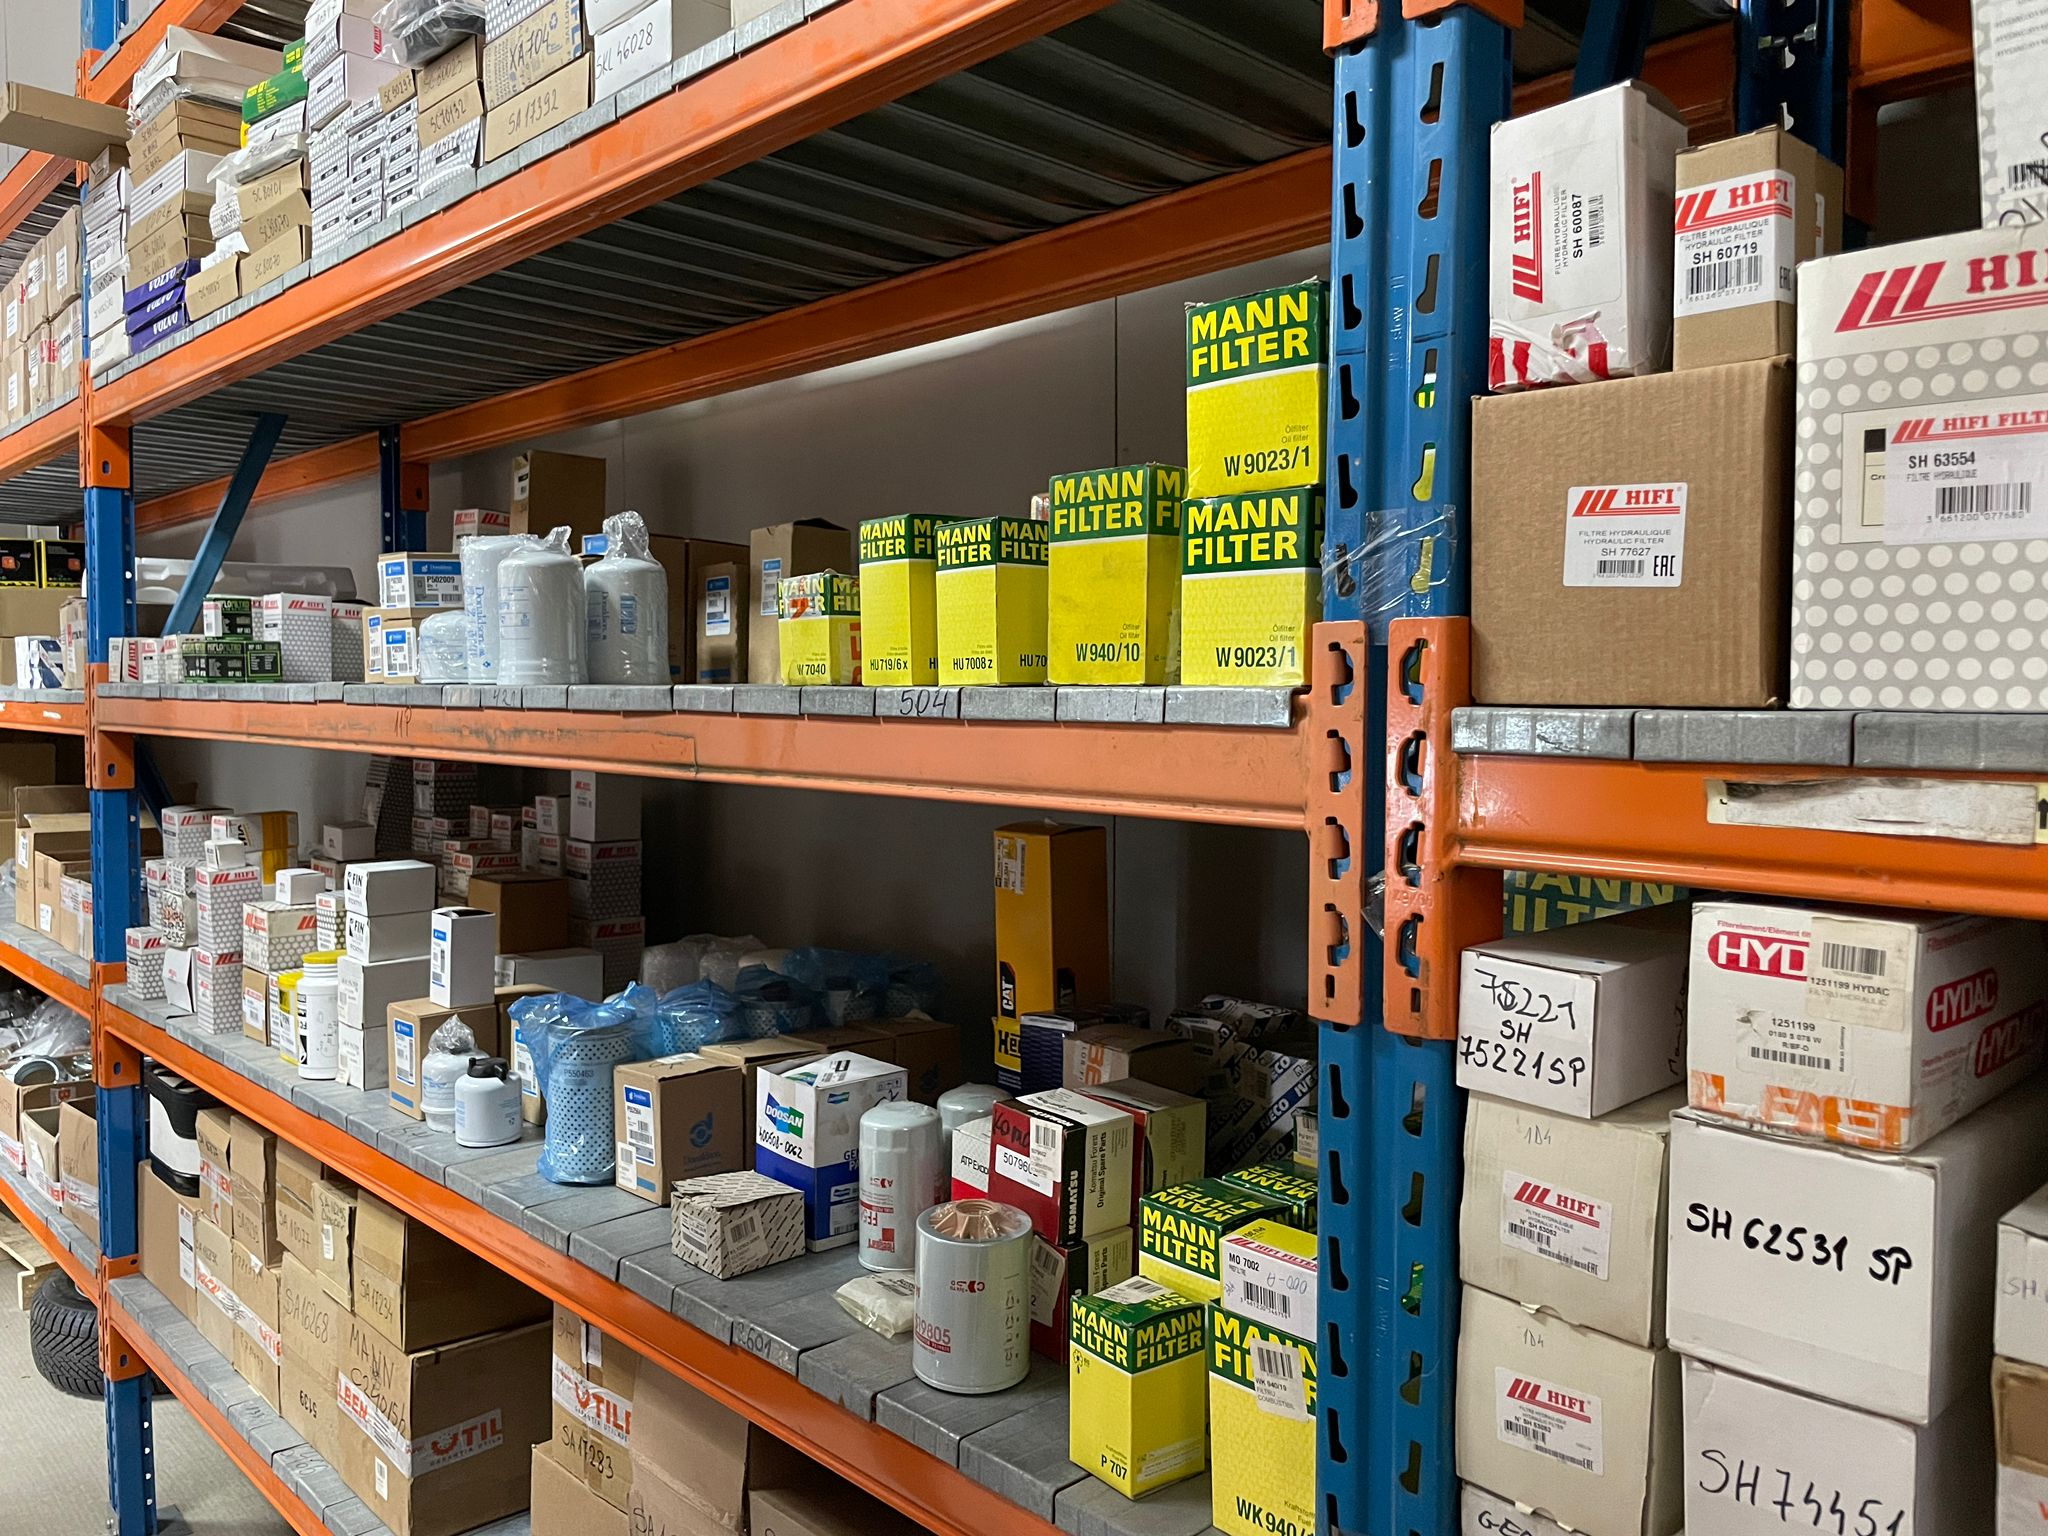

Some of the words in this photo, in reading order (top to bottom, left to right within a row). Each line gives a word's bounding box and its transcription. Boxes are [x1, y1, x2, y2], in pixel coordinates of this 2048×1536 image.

[527, 24, 551, 59] 704
[1560, 189, 1568, 217] FILTER
[1729, 178, 1789, 208] HIFI
[1513, 182, 1531, 244] HIFI
[1572, 194, 1582, 229] 60087
[1685, 236, 1731, 251] HYDRAULIC
[1734, 229, 1763, 244] FILTER
[1709, 218, 1770, 238] HYDRAULIQUE
[1572, 232, 1583, 258] SH
[1692, 251, 1712, 265] SH
[1717, 242, 1758, 261] 60719
[1966, 250, 2048, 294] HI
[152, 311, 179, 335] VOLVO
[1192, 291, 1308, 345] MANN
[1192, 327, 1309, 378] FILTER
[1942, 415, 1990, 431] HIFI
[1998, 409, 2048, 427] FILT
[1224, 456, 1240, 477] W
[1243, 445, 1310, 475] 9023/1
[1908, 455, 1928, 469] SH
[1934, 452, 1976, 467] 63554
[1054, 470, 1144, 505] MANN
[1625, 489, 1674, 505] HIFI
[1054, 500, 1143, 534] FILTER
[1188, 495, 1298, 535] MANN
[860, 518, 905, 540] MANN
[937, 523, 991, 548] MANN
[1001, 520, 1048, 541] MAN
[1634, 537, 1664, 545] FILTER
[860, 538, 906, 560] FILTER
[937, 544, 992, 567] FILTER
[1001, 541, 1048, 561] FILTE
[1187, 530, 1298, 567] FILTER
[1601, 549, 1617, 557] SH
[1620, 548, 1651, 557] 77627
[1653, 555, 1676, 577] EAC
[870, 659, 879, 671] HU
[880, 657, 902, 671] 719/6
[953, 658, 964, 671] HU
[965, 657, 986, 671] 7008
[1019, 654, 1033, 667] HU
[1075, 643, 1088, 662] W
[1091, 642, 1140, 662] 940/10
[1216, 646, 1231, 668] W
[1234, 646, 1296, 669] 9023/1
[805, 663, 826, 676] 7040
[1718, 934, 1808, 977] HYD
[1002, 976, 1015, 1010] CAT
[1810, 977, 1850, 989] 1251199
[1852, 984, 1890, 996] HYDAC
[1930, 973, 1996, 1029] HYDAC
[1500, 1020, 1532, 1043] SH
[1772, 1018, 1816, 1032] 1251199
[766, 1105, 803, 1128] DOOSAN
[1099, 1132, 1107, 1152] Parts
[1089, 1160, 1098, 1194] Komatsu
[1068, 1170, 1079, 1235] KOMATSU
[1150, 1191, 1232, 1222] MANN
[1557, 1194, 1595, 1217] HIFI
[1144, 1206, 1216, 1250] MANN
[1143, 1228, 1216, 1273] FILTER
[1686, 1203, 1732, 1240] SH
[1743, 1218, 1848, 1272] 62531
[1868, 1246, 1913, 1285] SP
[1229, 1253, 1241, 1264] MO
[1243, 1258, 1260, 1272] 7002
[1073, 1302, 1127, 1347] MANN
[1137, 1310, 1202, 1348] MANN
[1073, 1322, 1128, 1367] FILTER
[1137, 1330, 1202, 1367] FILTER
[1547, 1390, 1585, 1412] HIFI
[561, 1425, 577, 1452] SA
[1101, 1454, 1107, 1468] P
[1110, 1459, 1128, 1481] 707
[1699, 1450, 1760, 1506] SH
[1236, 1496, 1264, 1529] WK
